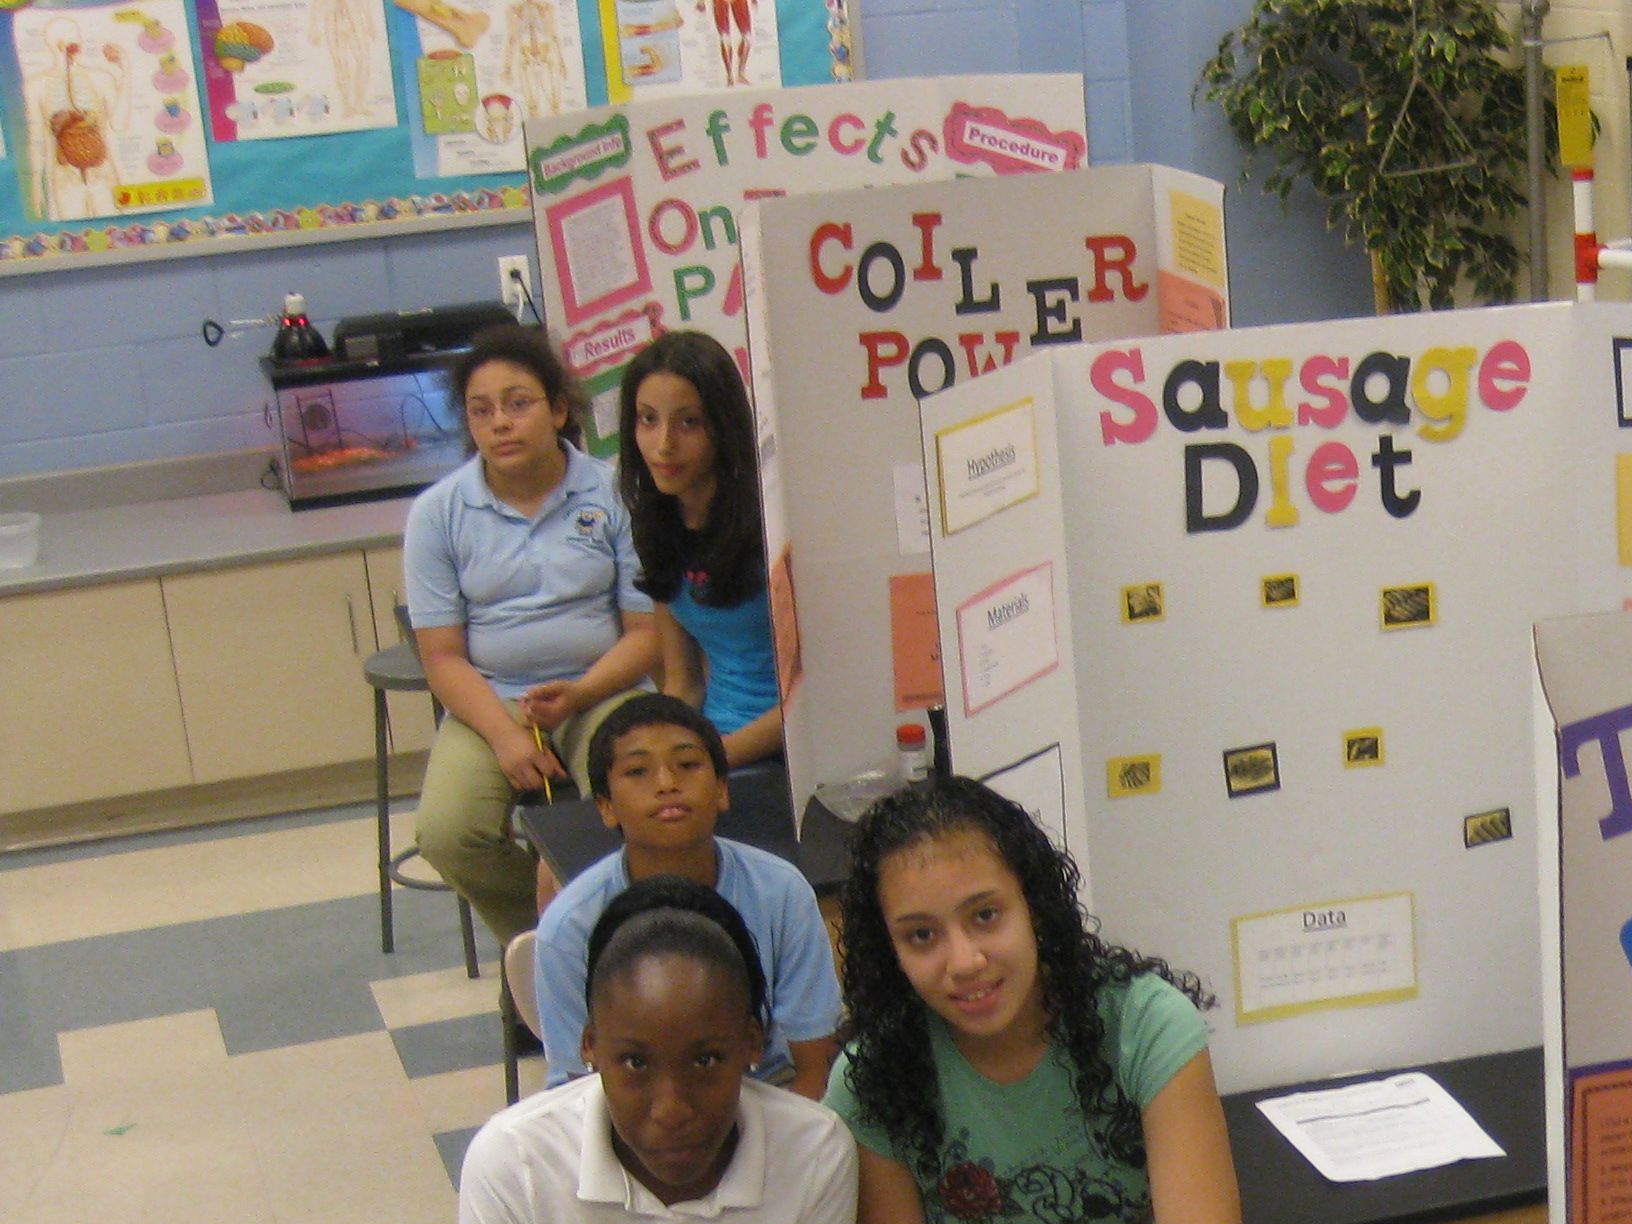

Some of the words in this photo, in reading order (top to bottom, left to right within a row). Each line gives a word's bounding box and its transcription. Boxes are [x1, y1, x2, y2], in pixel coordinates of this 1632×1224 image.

[647, 102, 939, 182] Effects
[968, 126, 1060, 165] Procedure
[649, 197, 738, 257] On
[809, 212, 1149, 347] COILER
[582, 326, 637, 361] Results
[1089, 339, 1532, 447] Sausage
[966, 442, 1017, 478] Hypothesis
[985, 592, 1030, 628] Materials
[1302, 909, 1347, 930] Data
